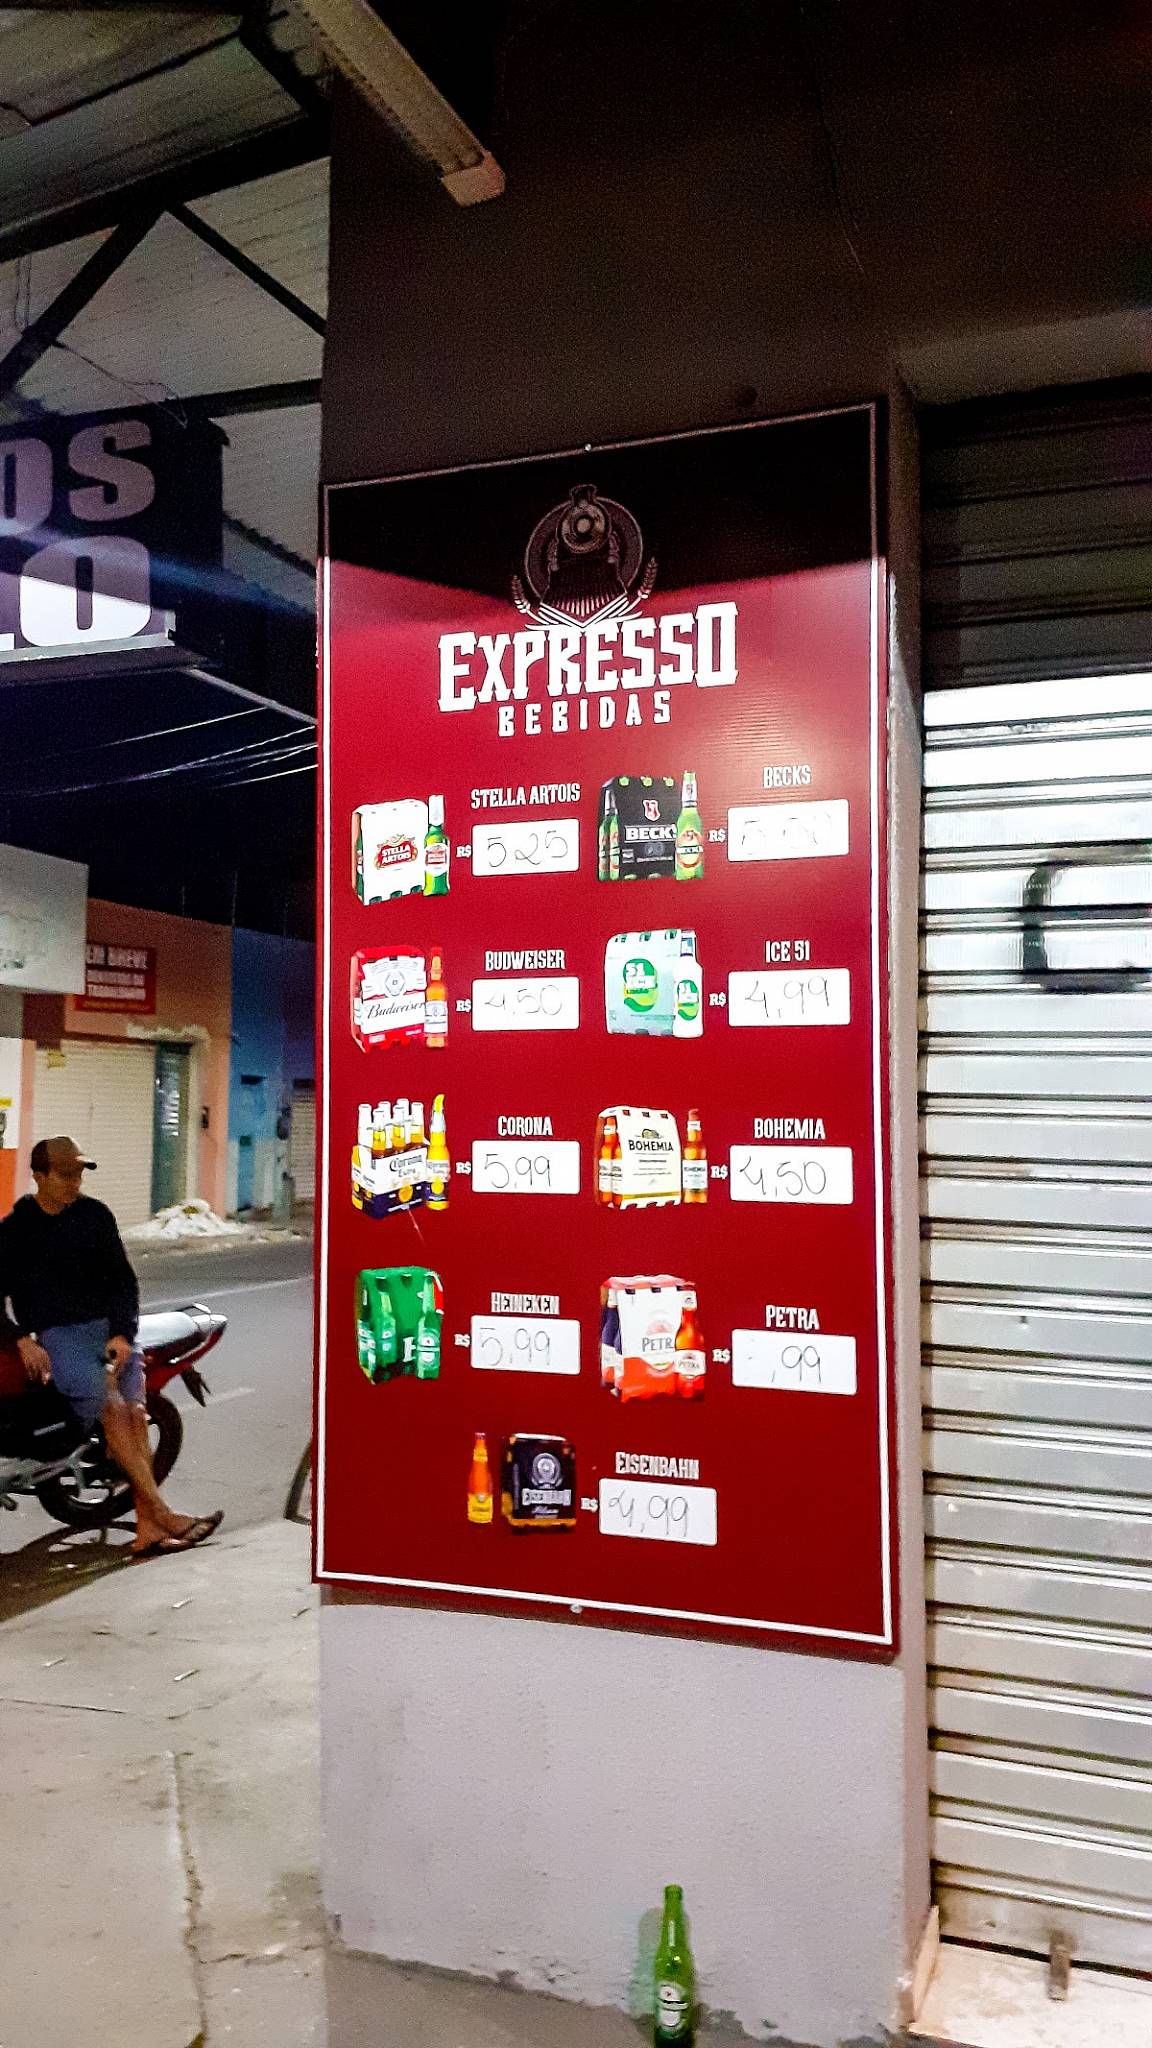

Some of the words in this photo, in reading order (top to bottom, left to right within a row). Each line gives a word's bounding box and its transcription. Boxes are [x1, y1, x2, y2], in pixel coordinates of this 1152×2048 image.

[0, 535, 151, 648] O
[438, 602, 739, 712] EXPRESSO
[498, 691, 672, 736] BEBIDAS
[763, 765, 812, 789] BECKS
[471, 786, 526, 809] STELLA
[529, 783, 580, 805] ARTOIS
[708, 828, 727, 843] R$
[456, 844, 472, 858] R$
[485, 950, 566, 972] BUDWEISER
[765, 941, 791, 963] ICE
[793, 940, 810, 961] 51
[709, 993, 727, 1007] R$
[497, 1115, 553, 1137] CORONA
[754, 1118, 826, 1139] BOHEMIA
[628, 1139, 674, 1151] BOHEMIA
[456, 1161, 472, 1175] R$
[711, 1165, 728, 1180] R$
[766, 1304, 820, 1330] PETRA
[642, 1337, 674, 1352] PETR
[615, 1451, 700, 1480] EISENBAHN
